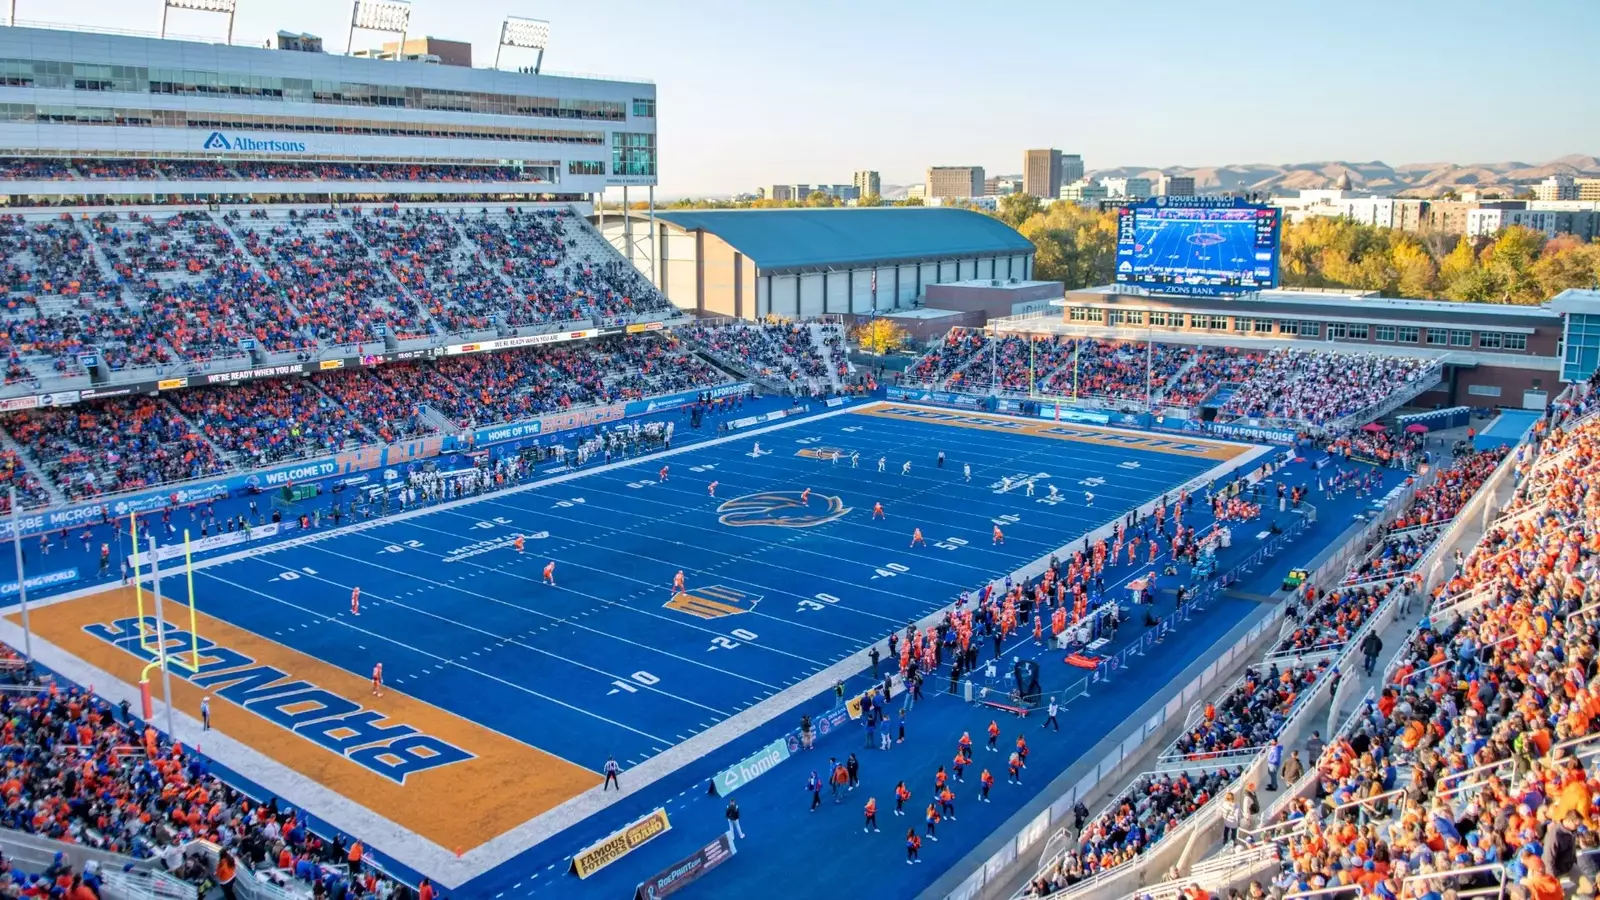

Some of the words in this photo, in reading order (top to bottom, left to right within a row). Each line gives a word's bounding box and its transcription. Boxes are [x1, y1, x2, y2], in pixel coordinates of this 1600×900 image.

[233, 137, 306, 152] Albertsons
[1166, 286, 1190, 294] ZIONS
[1192, 287, 1215, 295] BANK
[208, 374, 230, 383] WE'RE
[231, 370, 254, 381] READY
[254, 367, 275, 378] WHEN
[275, 365, 290, 375] YOU
[290, 363, 303, 373] ARE
[488, 428, 511, 441] HOME
[513, 427, 524, 437] OF
[525, 424, 539, 434] THE
[266, 465, 319, 484] WELCOME
[320, 463, 334, 473] TO
[335, 449, 382, 474] THE
[476, 516, 513, 529] 30
[383, 539, 424, 553] 20
[933, 537, 969, 550] 50
[43, 569, 76, 584] WORLD
[279, 567, 319, 581] 10
[875, 563, 910, 577] 40
[798, 592, 841, 611] 30
[711, 628, 759, 650] 20
[611, 670, 661, 693] 10
[82, 615, 479, 786] BRONCOS
[740, 750, 781, 782] homie
[629, 820, 662, 843] IDAHO
[580, 835, 625, 865] FAMOUS
[582, 844, 628, 875] POTATOES
